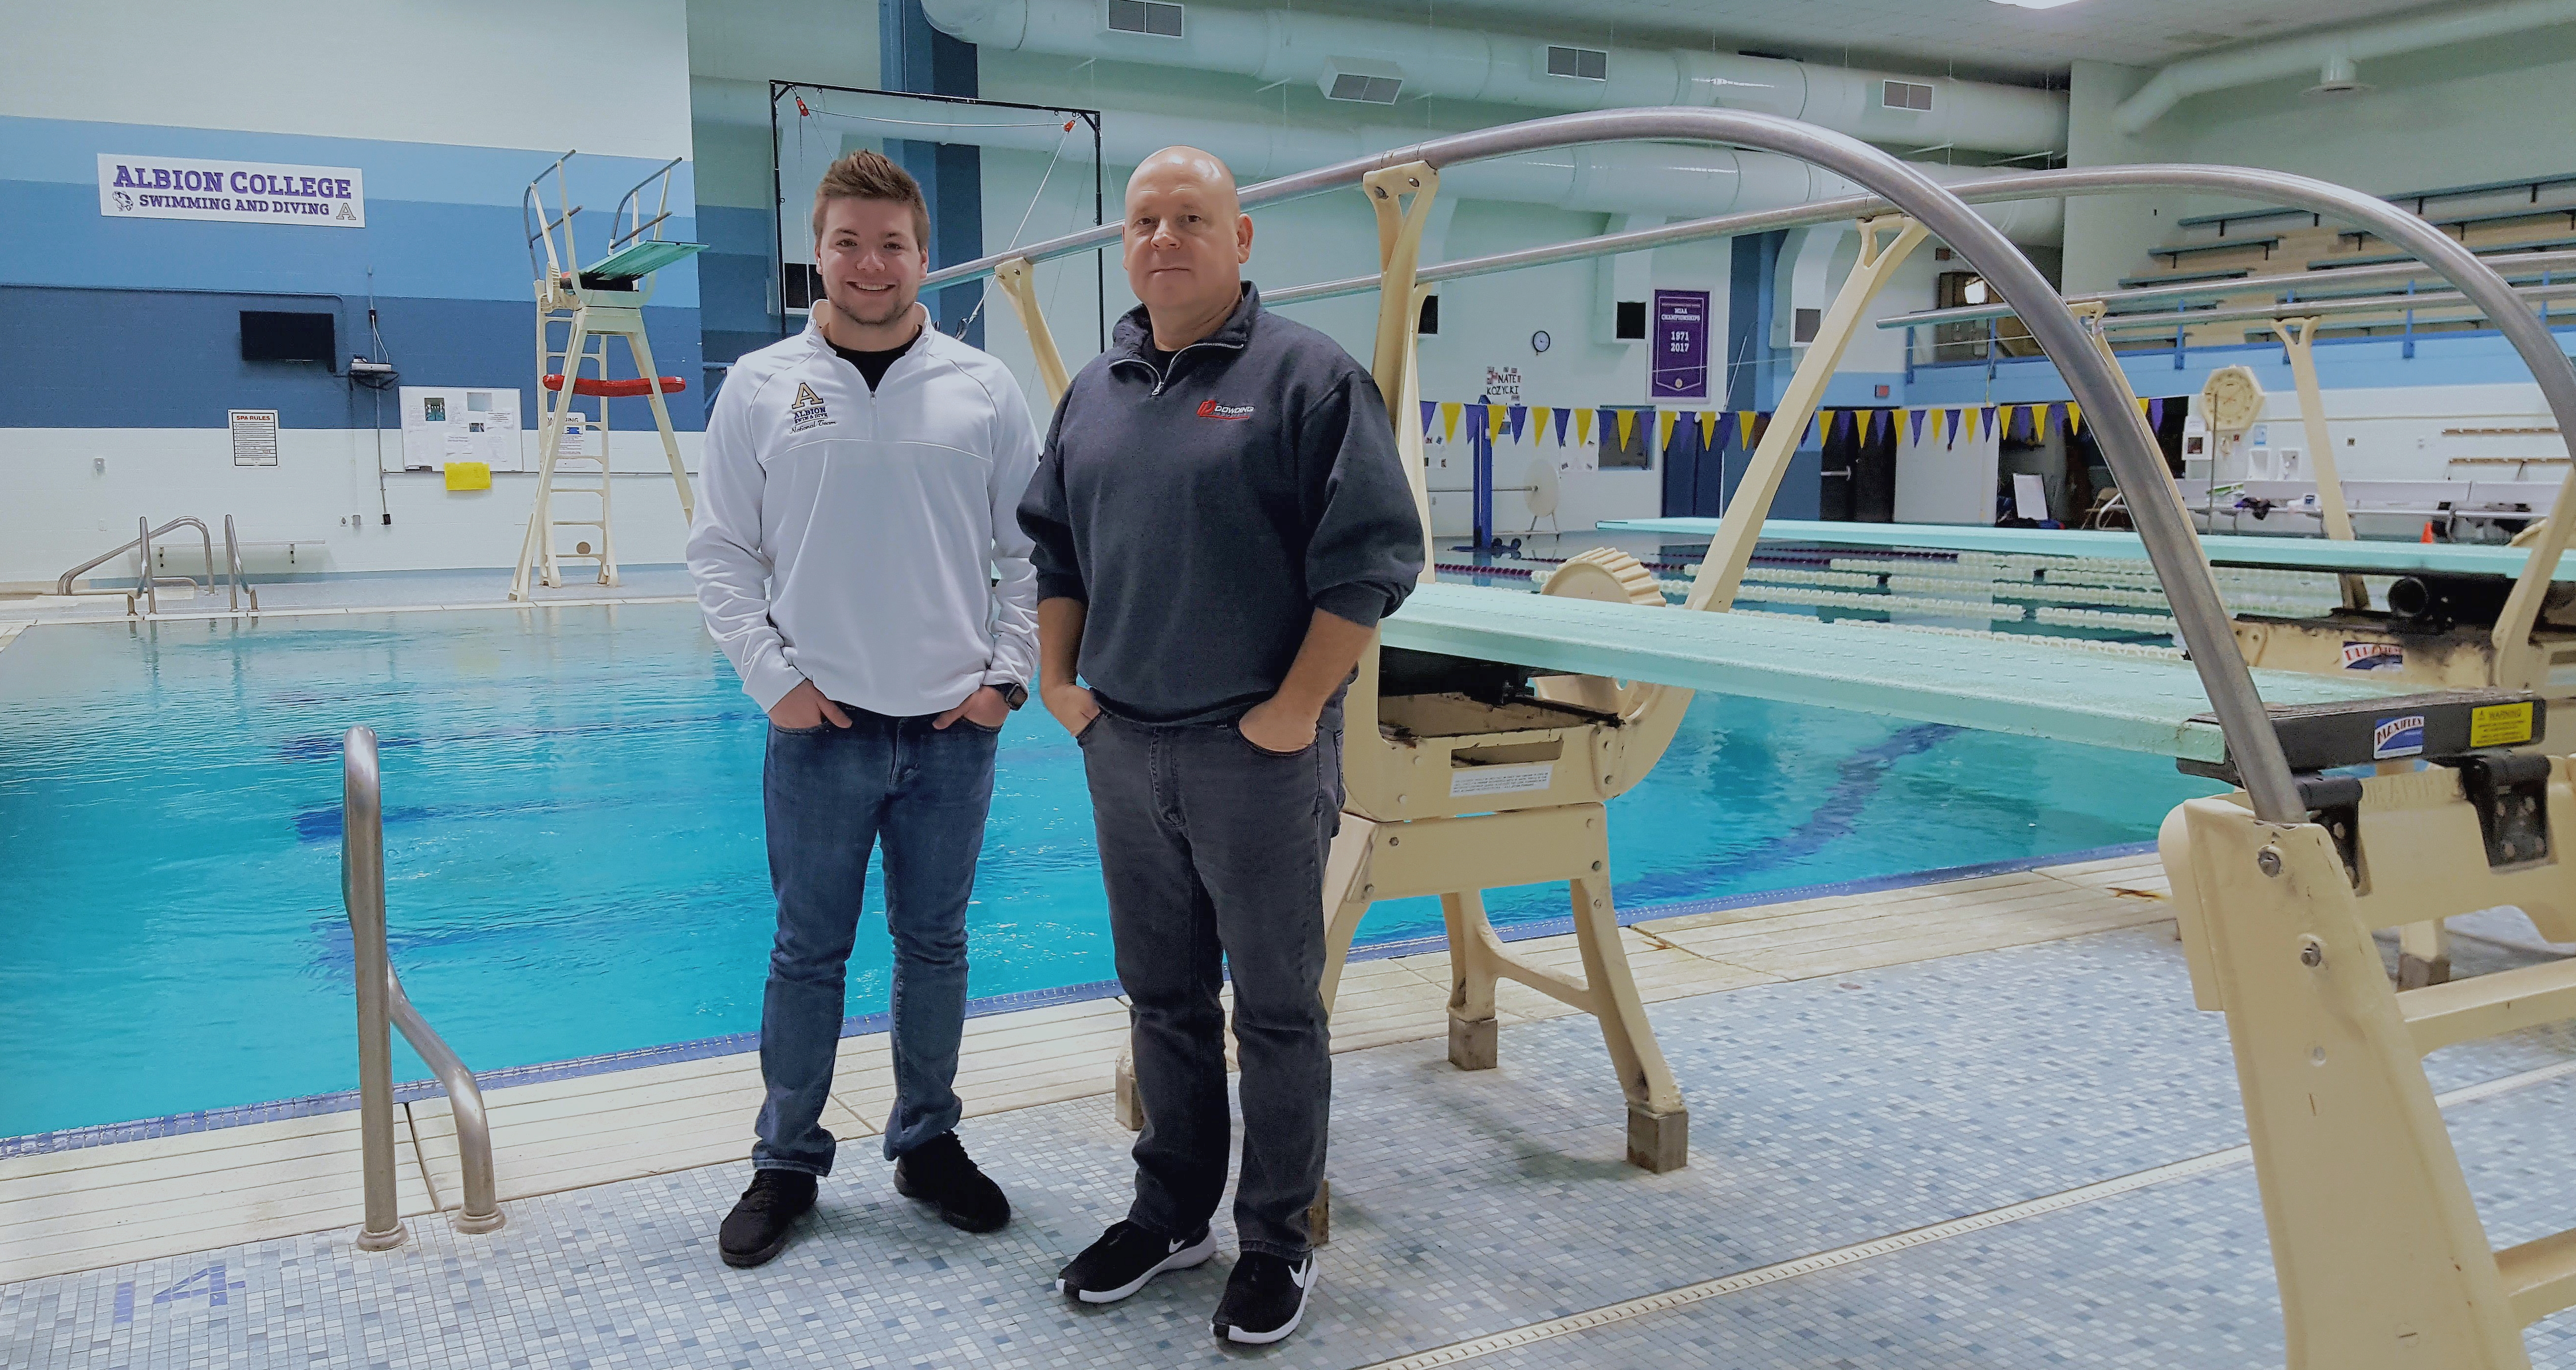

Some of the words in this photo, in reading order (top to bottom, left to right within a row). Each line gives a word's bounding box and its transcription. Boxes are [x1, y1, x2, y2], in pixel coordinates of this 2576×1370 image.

[113, 165, 223, 192] ALBION
[230, 171, 352, 199] COLLEGE
[139, 194, 230, 211] SWIMMING
[234, 199, 269, 213] AND
[273, 201, 329, 216] DIVING
[336, 202, 356, 221] A
[1671, 331, 1689, 341] 1971
[1670, 342, 1690, 352] 2017
[791, 382, 824, 410] A
[794, 407, 827, 419] ALBION
[1214, 405, 1255, 414] DOWDING
[794, 415, 809, 424] SWIM
